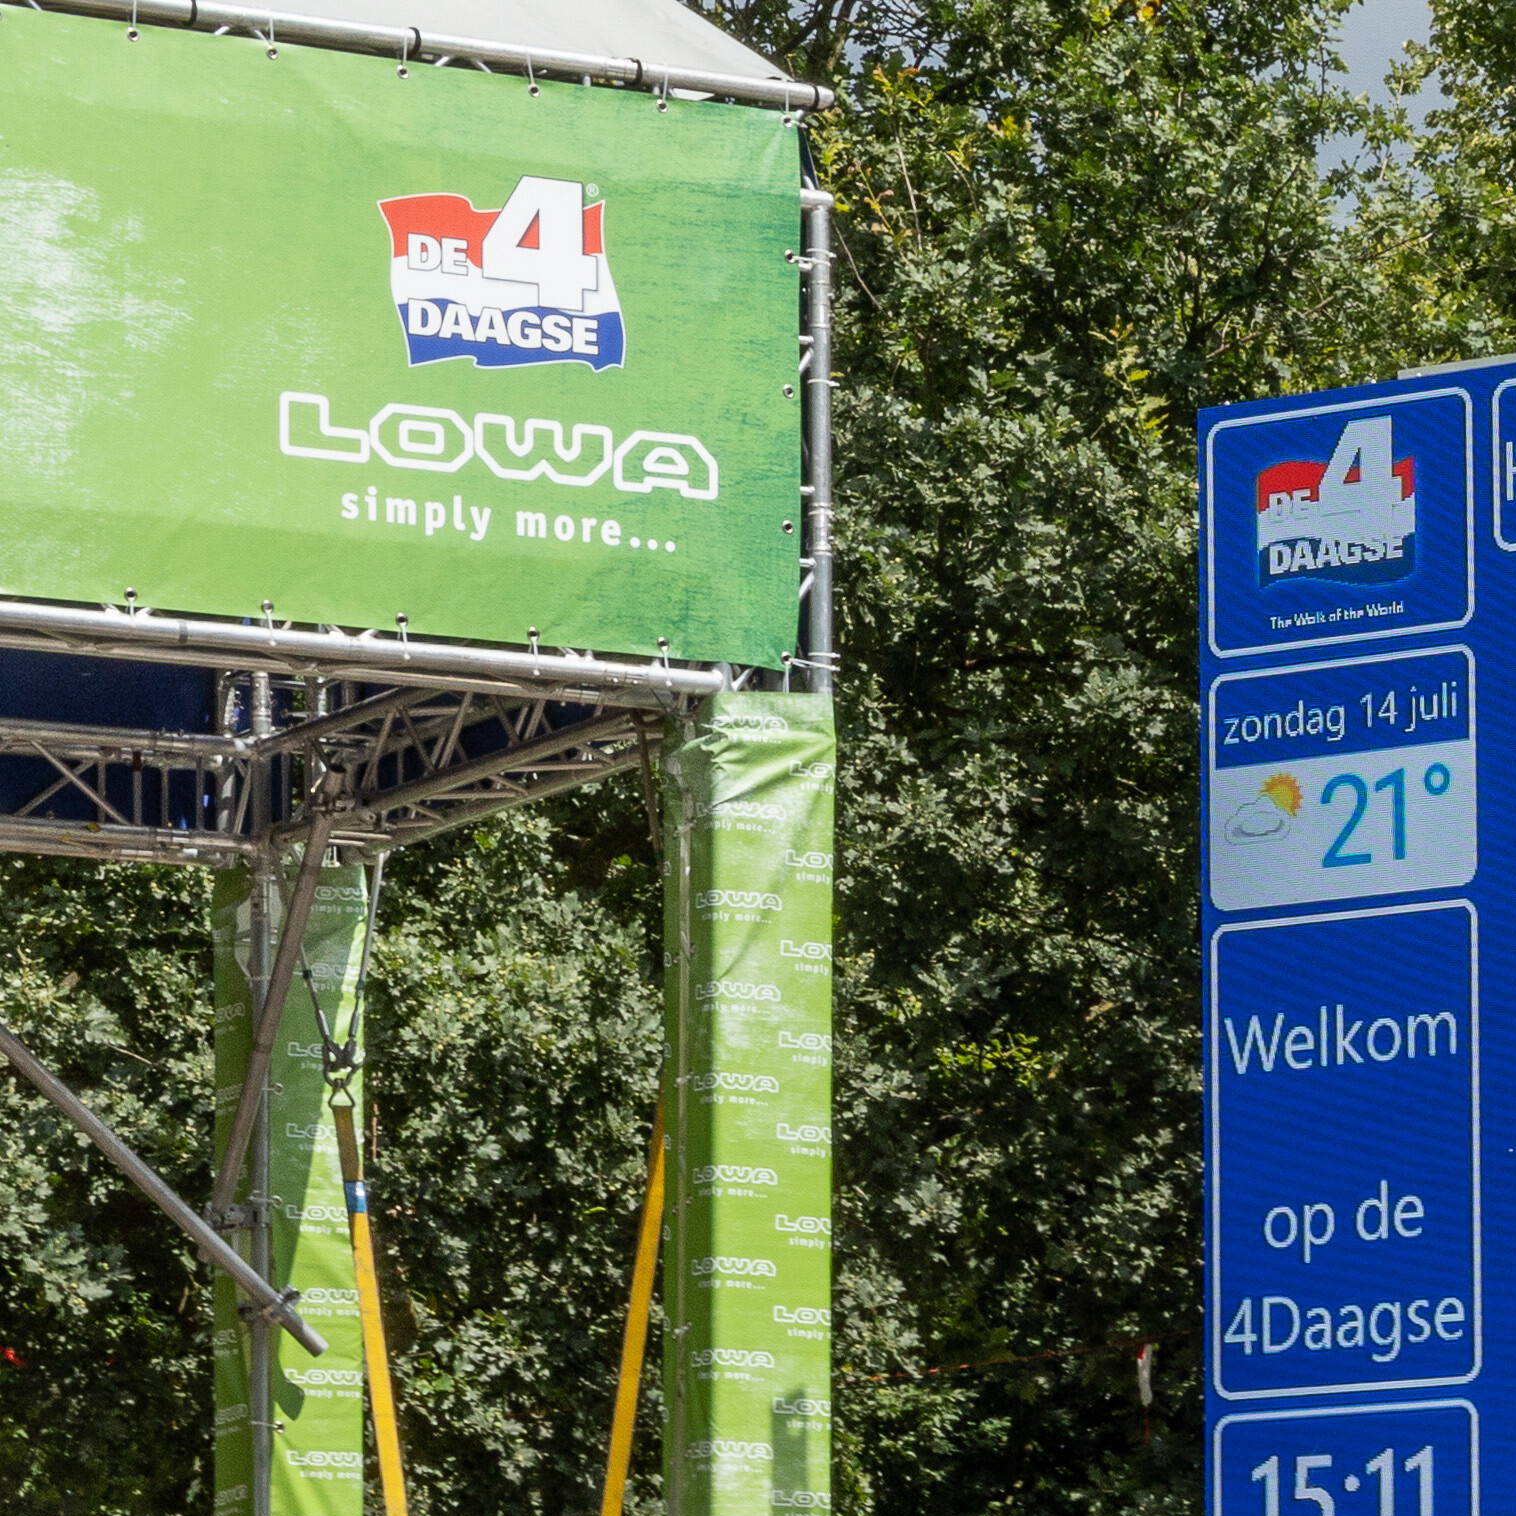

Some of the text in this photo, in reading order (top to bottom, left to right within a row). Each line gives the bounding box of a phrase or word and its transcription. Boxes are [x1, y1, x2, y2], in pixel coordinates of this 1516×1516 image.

[406, 175, 599, 313] DE 4
[406, 297, 600, 355] DAAGSE
[279, 391, 719, 501] LOWA
[1318, 414, 1403, 541] 4
[340, 485, 677, 553] simply more...
[1268, 535, 1404, 576] DAAGSE
[1270, 615, 1293, 631] The
[1344, 604, 1364, 621] the
[1223, 681, 1458, 742] zondag 14 juli
[1319, 761, 1451, 869] 21°
[1223, 1003, 1457, 1075] Welkom
[1263, 1179, 1425, 1264] op de
[1223, 1295, 1466, 1363] 4Daagse
[285, 1450, 363, 1467] LOW
